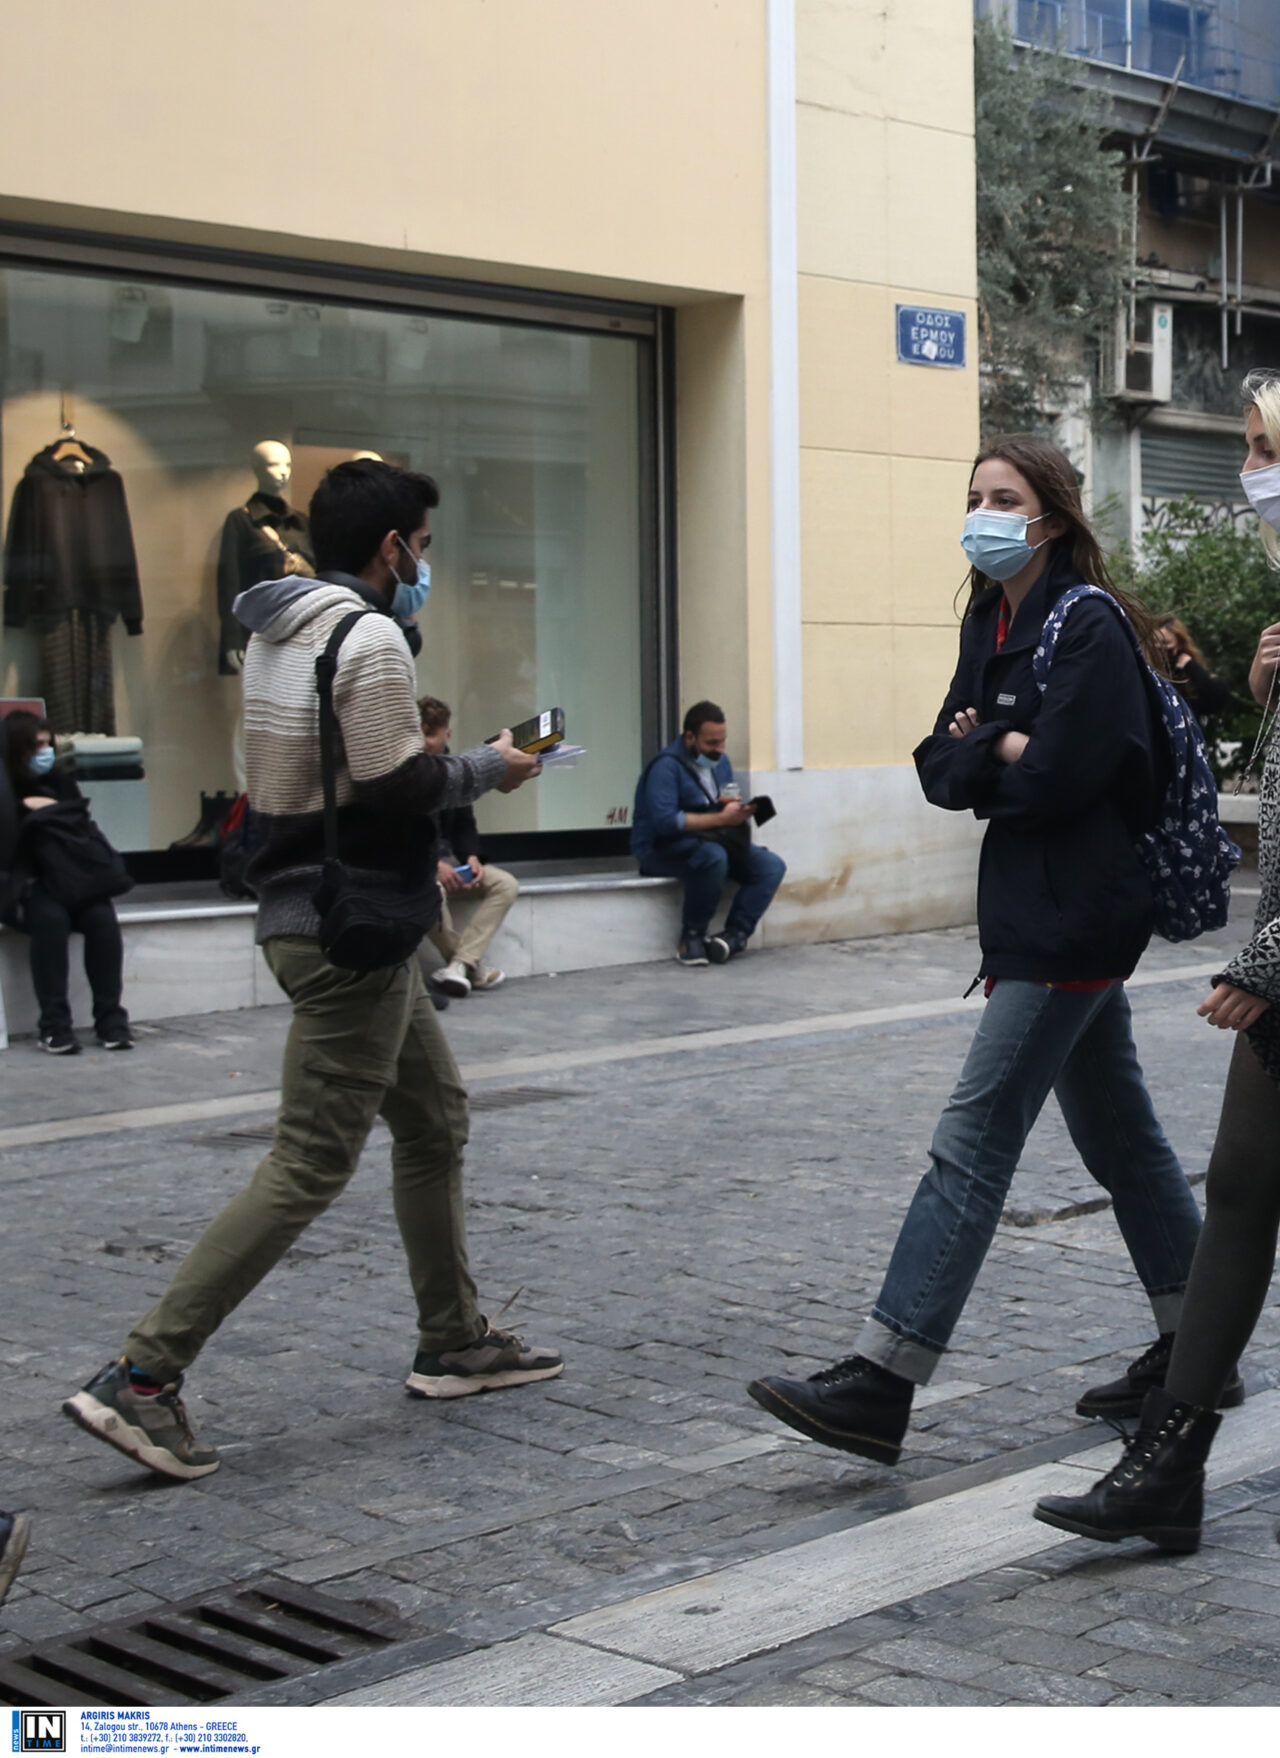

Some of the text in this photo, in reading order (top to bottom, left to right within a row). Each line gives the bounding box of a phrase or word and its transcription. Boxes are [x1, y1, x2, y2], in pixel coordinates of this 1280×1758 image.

[916, 312, 951, 328] ΟΔΟΣ
[911, 326, 955, 344] ΕΡΜΟΥ
[913, 342, 954, 359] EOU
